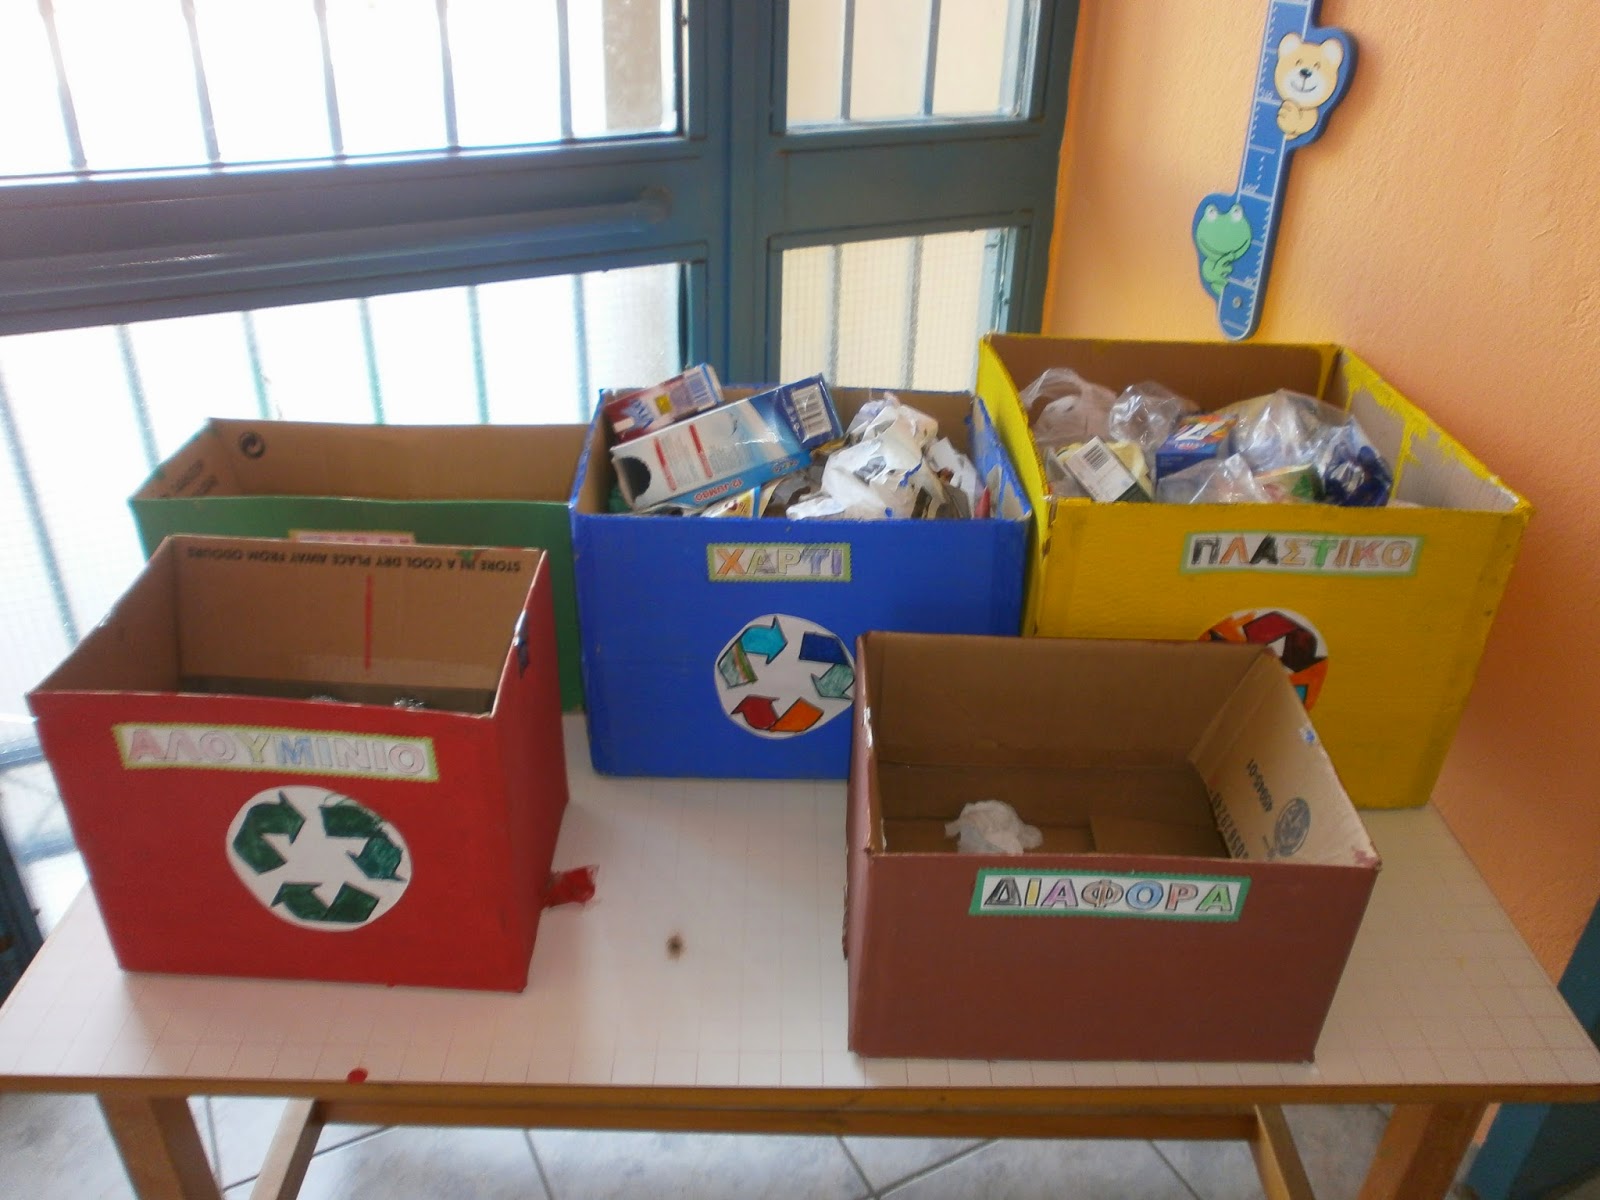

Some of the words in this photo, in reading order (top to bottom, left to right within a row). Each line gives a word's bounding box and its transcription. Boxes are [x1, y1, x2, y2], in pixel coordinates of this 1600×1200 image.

[247, 550, 285, 563] FROM
[1190, 534, 1414, 567] ΠΛΑΣΤΙΚΟ
[289, 552, 328, 565] AWAY
[331, 554, 371, 567] PLACE
[377, 555, 402, 568] DRY
[406, 556, 442, 569] COOL
[447, 559, 455, 569] A
[715, 547, 843, 577] ΧΑΡΤΙ
[481, 559, 521, 572] STORE
[127, 728, 426, 775] ΑΛΟΥΜΙΝΙΟ
[983, 876, 1233, 912] ΔΙΑΦΟΡΑ
